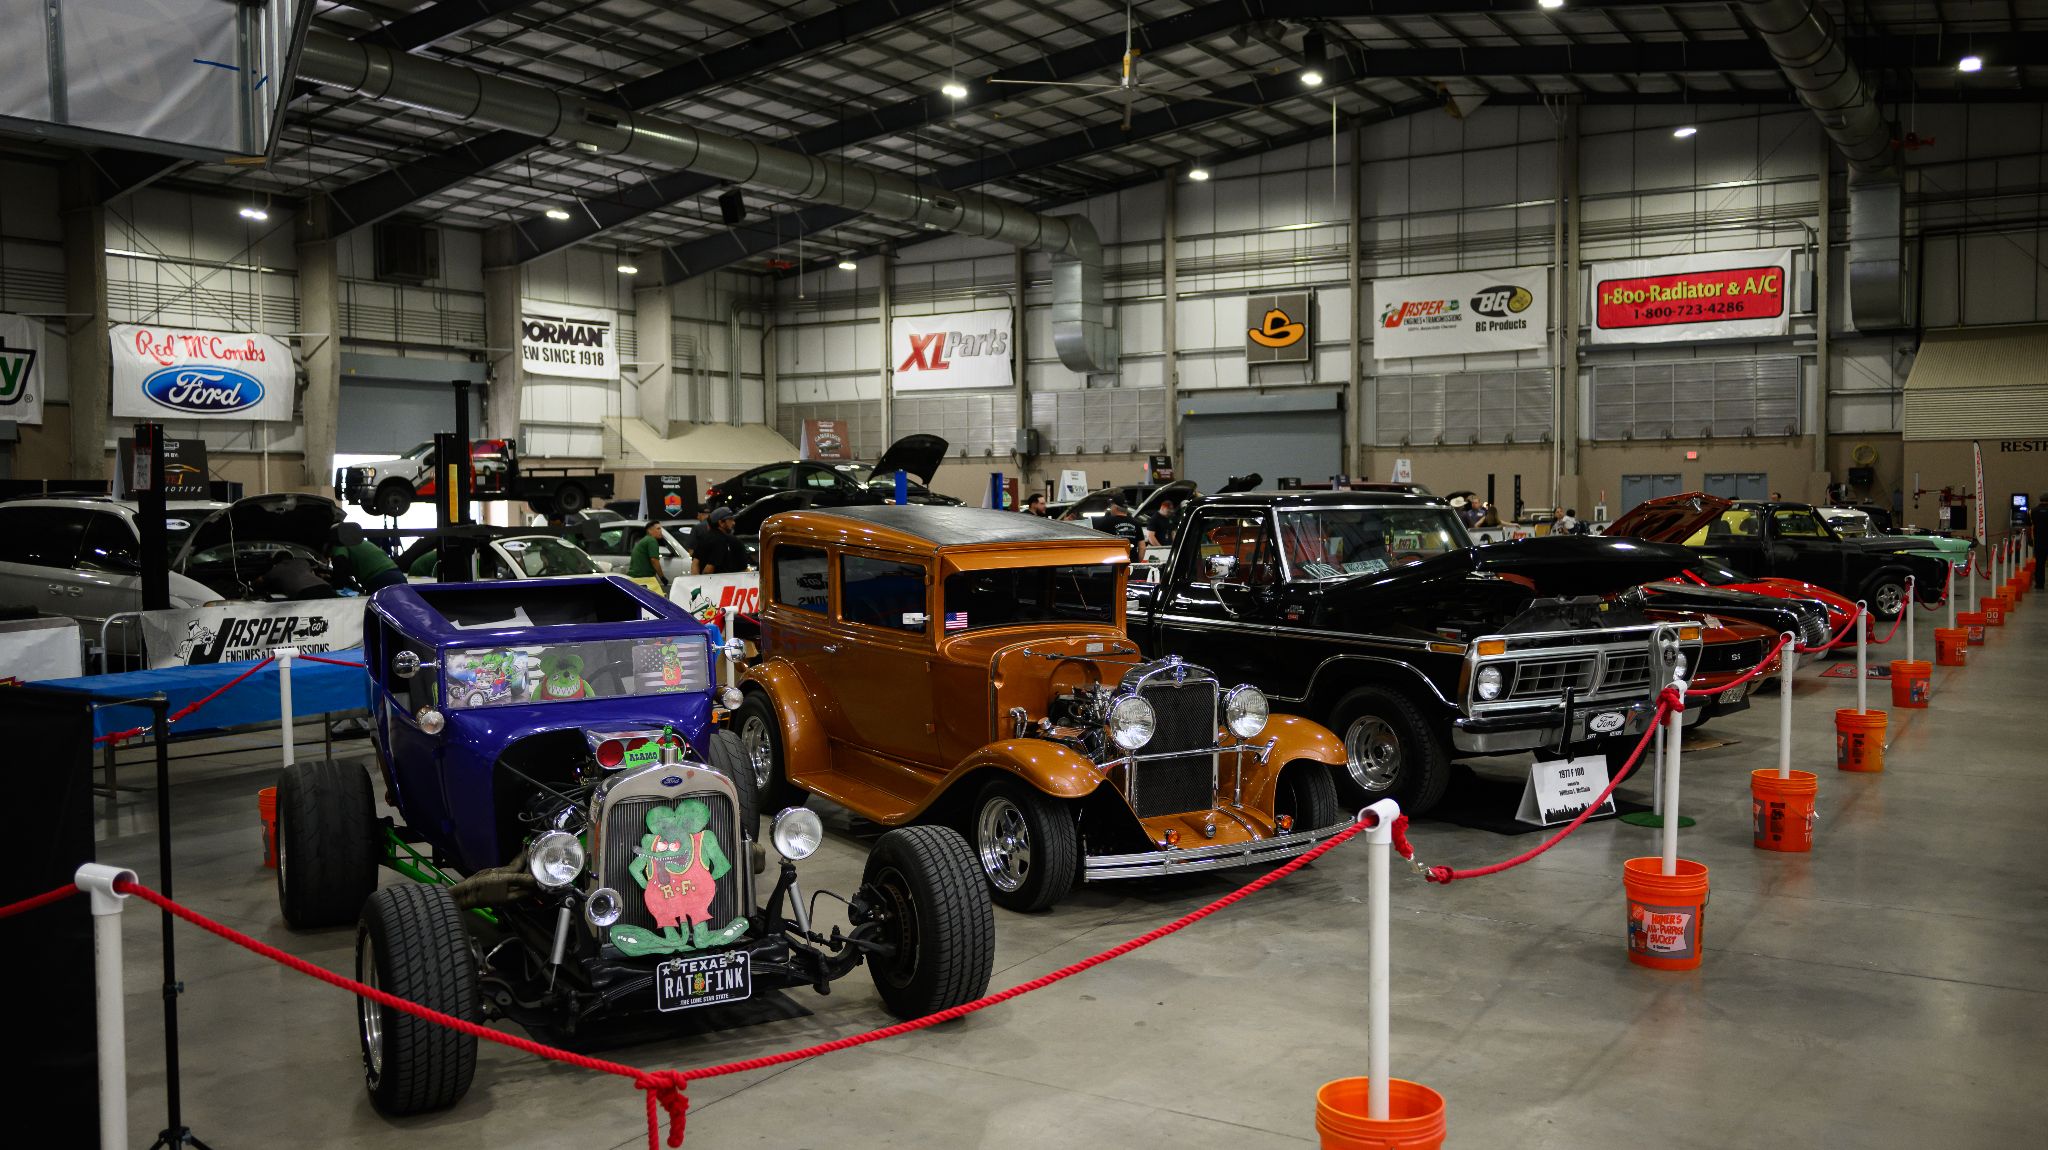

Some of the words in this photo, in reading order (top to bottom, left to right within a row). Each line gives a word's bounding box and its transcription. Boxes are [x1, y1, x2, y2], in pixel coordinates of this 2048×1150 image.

[1603, 281, 1724, 305] 1-800-Radiator
[1727, 281, 1740, 296] &
[1744, 275, 1777, 295] A/C
[1476, 291, 1511, 312] BG
[1634, 301, 1744, 319] 1-800-723-4286
[1385, 299, 1445, 328] JASPER
[1475, 321, 1486, 332] BG
[1489, 318, 1527, 331] Products
[136, 329, 174, 366] Red
[523, 345, 539, 360] EW
[543, 347, 576, 364] SINCE
[579, 350, 604, 366] 1918
[169, 371, 243, 406] Ford
[311, 622, 323, 632] GO!
[188, 616, 299, 665] JASPER
[1597, 715, 1618, 728] Ford
[629, 752, 657, 761] ALAMO
[1650, 934, 1677, 945] BUCKET
[680, 957, 728, 974] TEXAS
[664, 974, 693, 999] RAT
[705, 967, 743, 993] FINK
